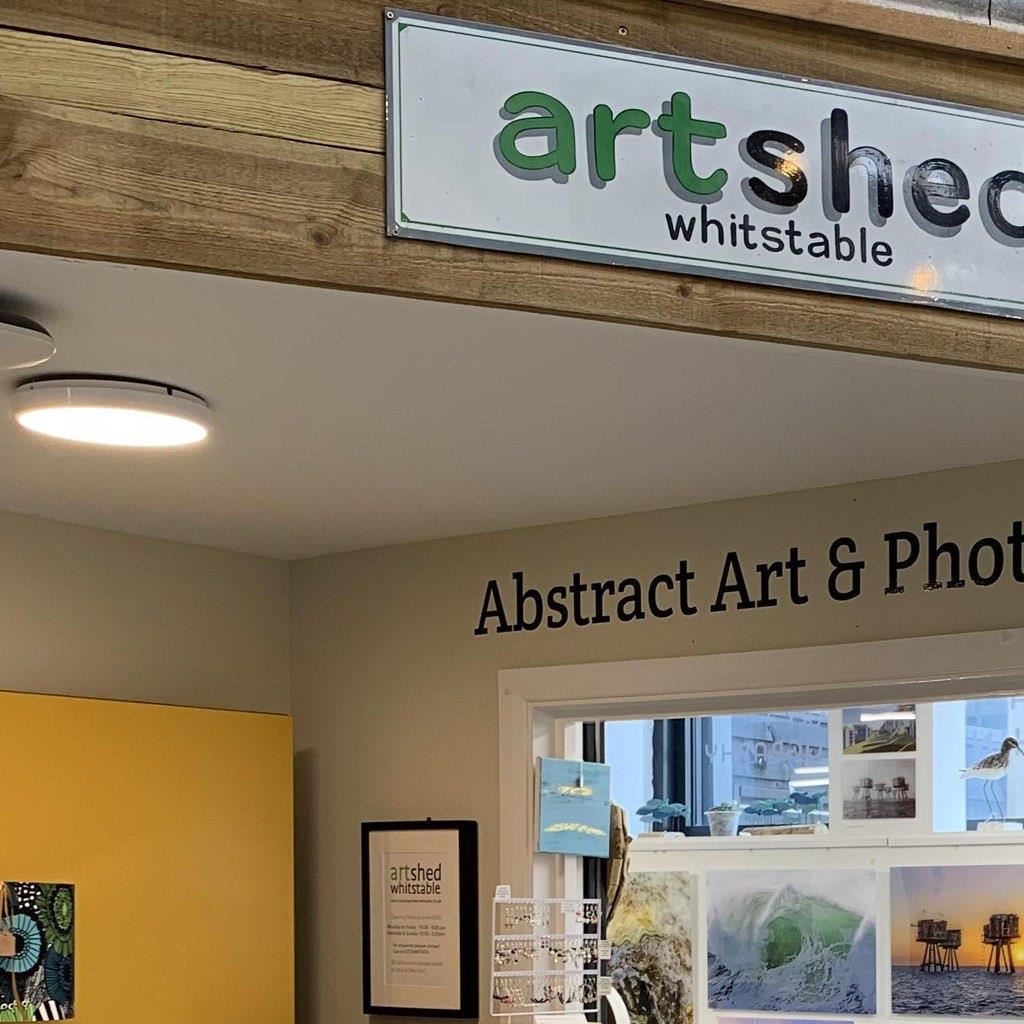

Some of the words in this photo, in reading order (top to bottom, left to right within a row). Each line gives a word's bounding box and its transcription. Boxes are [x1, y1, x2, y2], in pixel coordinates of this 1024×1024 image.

[665, 205, 893, 267] whitstable
[474, 560, 698, 635] Abstract
[710, 547, 809, 613] Art
[827, 536, 865, 601] &
[390, 862, 442, 881] artshed
[390, 881, 442, 895] whitstable
